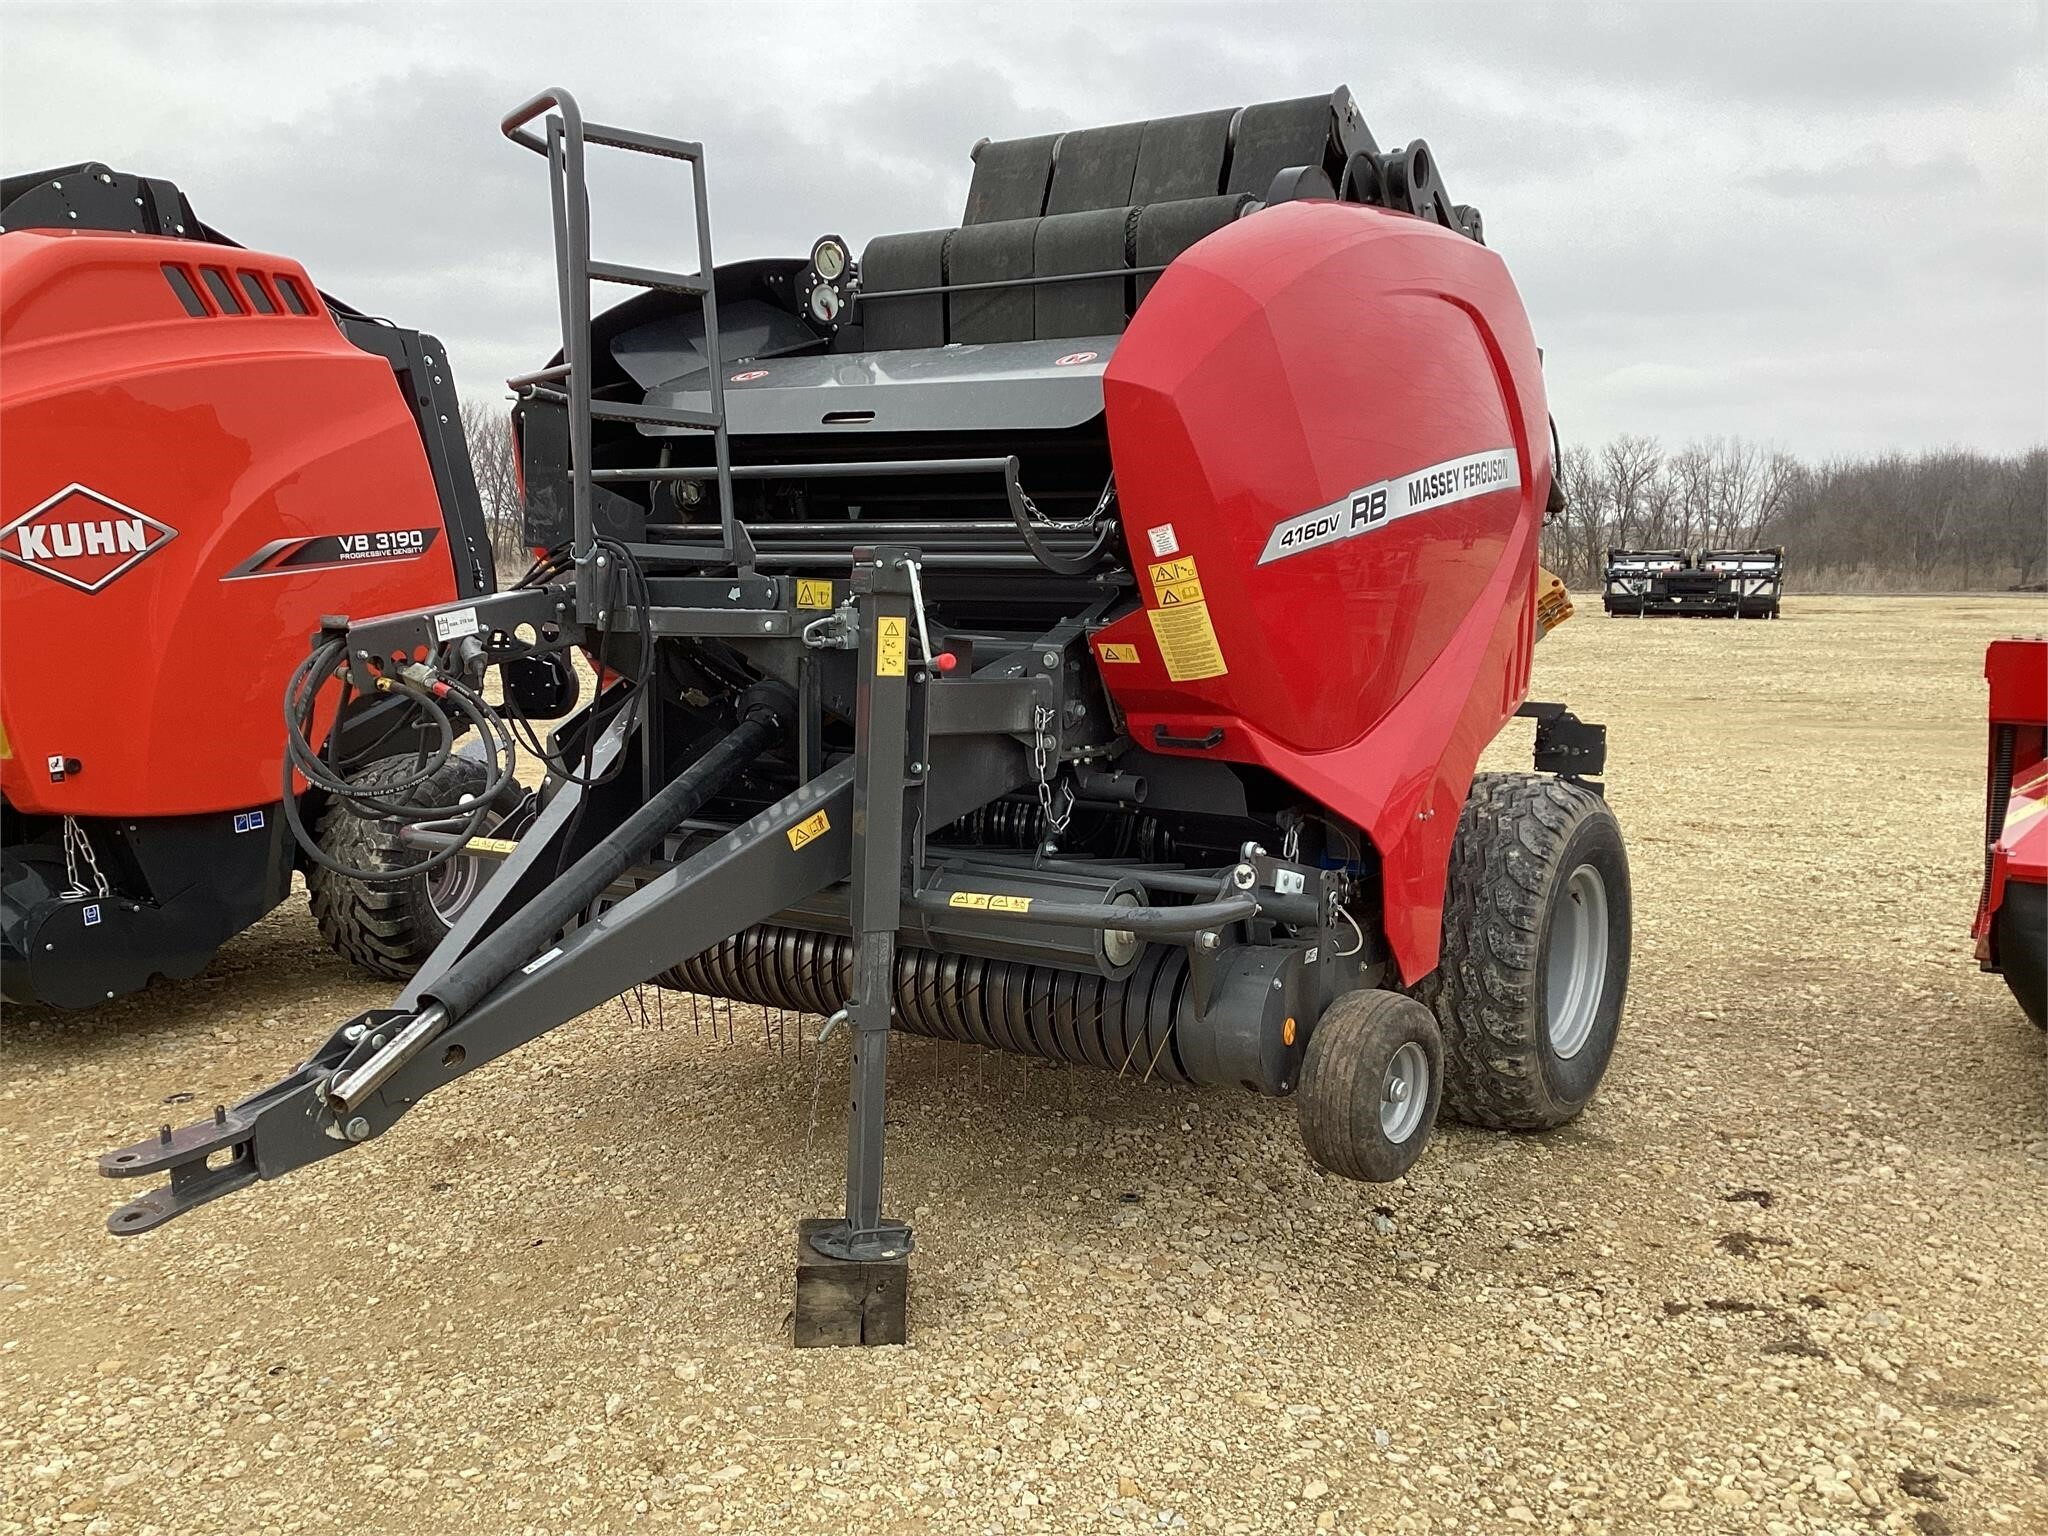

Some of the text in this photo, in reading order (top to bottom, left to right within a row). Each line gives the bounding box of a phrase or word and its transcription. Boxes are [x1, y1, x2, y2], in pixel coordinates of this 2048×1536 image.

[1280, 458, 1508, 546] 4160V RB MASSEY FERGUSON
[17, 519, 147, 560] KUHN
[338, 530, 423, 552] VB 3190
[340, 547, 423, 560] PROGRESSIVE DENSITY
